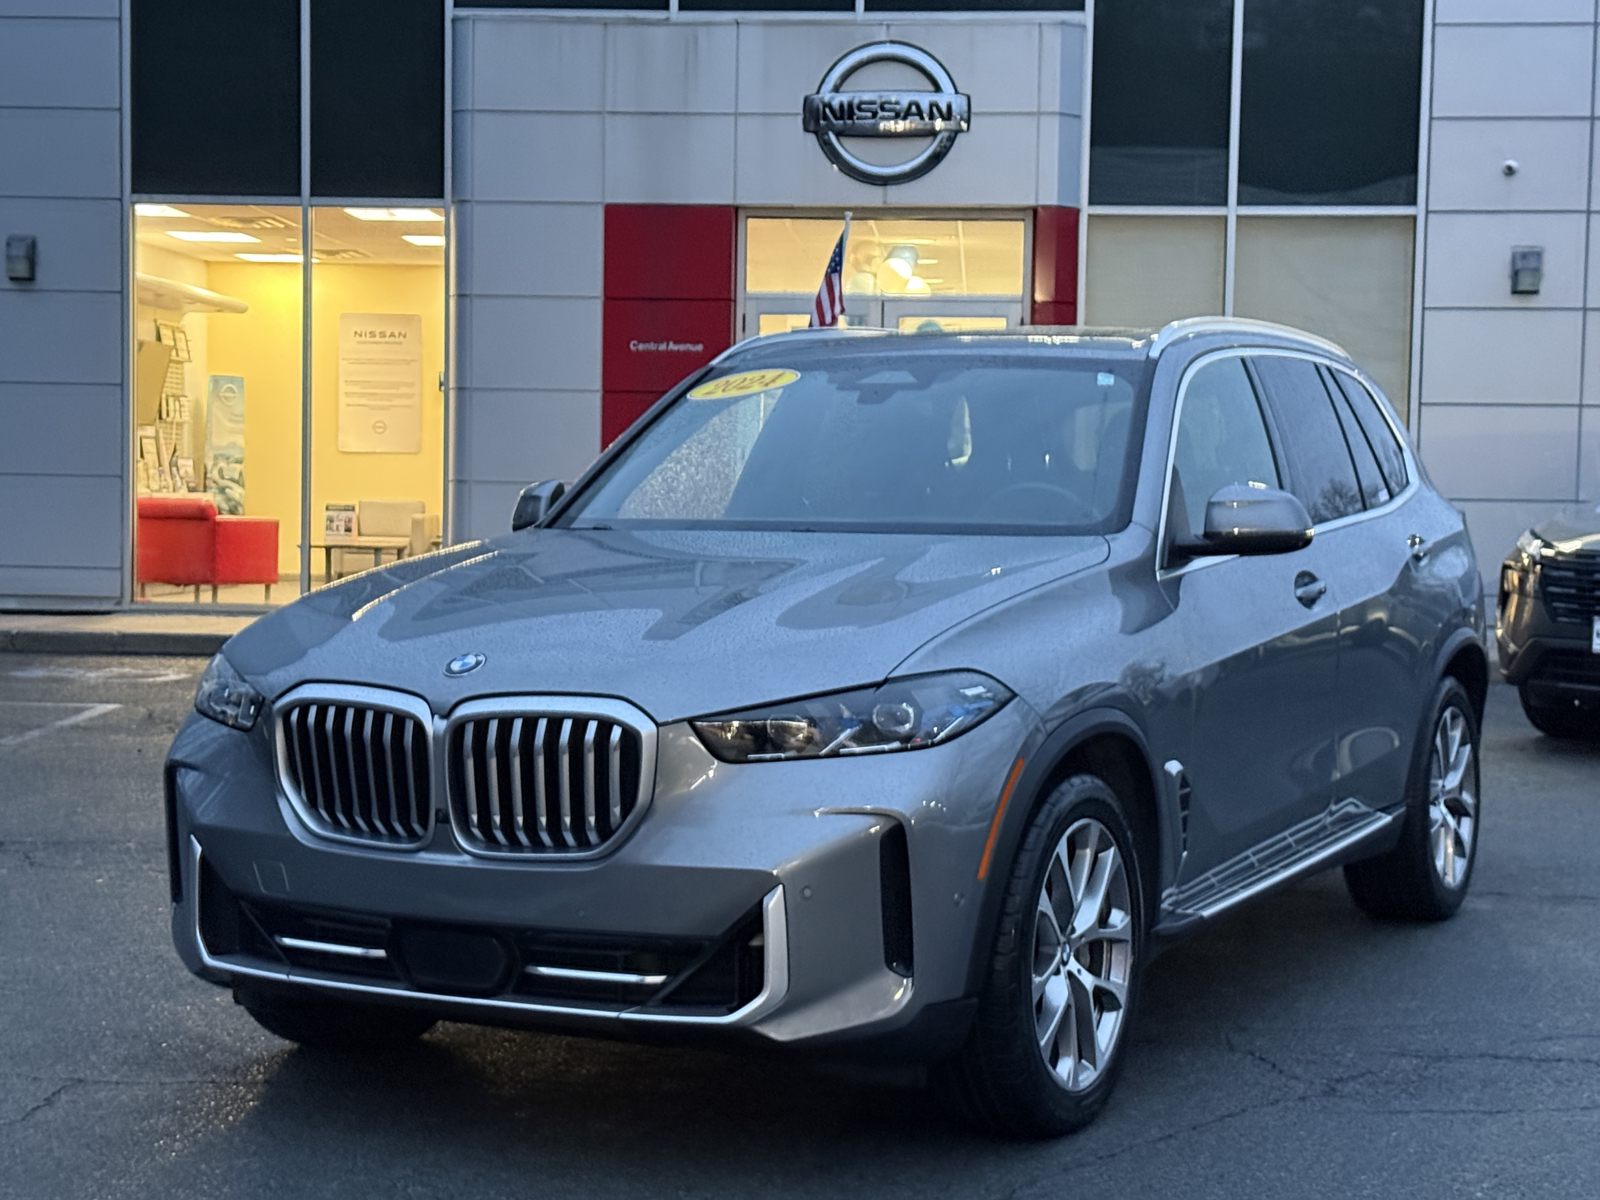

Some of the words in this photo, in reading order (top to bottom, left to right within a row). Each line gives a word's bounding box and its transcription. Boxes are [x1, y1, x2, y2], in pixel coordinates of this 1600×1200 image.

[822, 100, 953, 121] NISSAN
[353, 330, 407, 339] NISSAN
[629, 340, 667, 351] Central
[668, 341, 704, 351] Avenue
[702, 371, 787, 396] 2024
